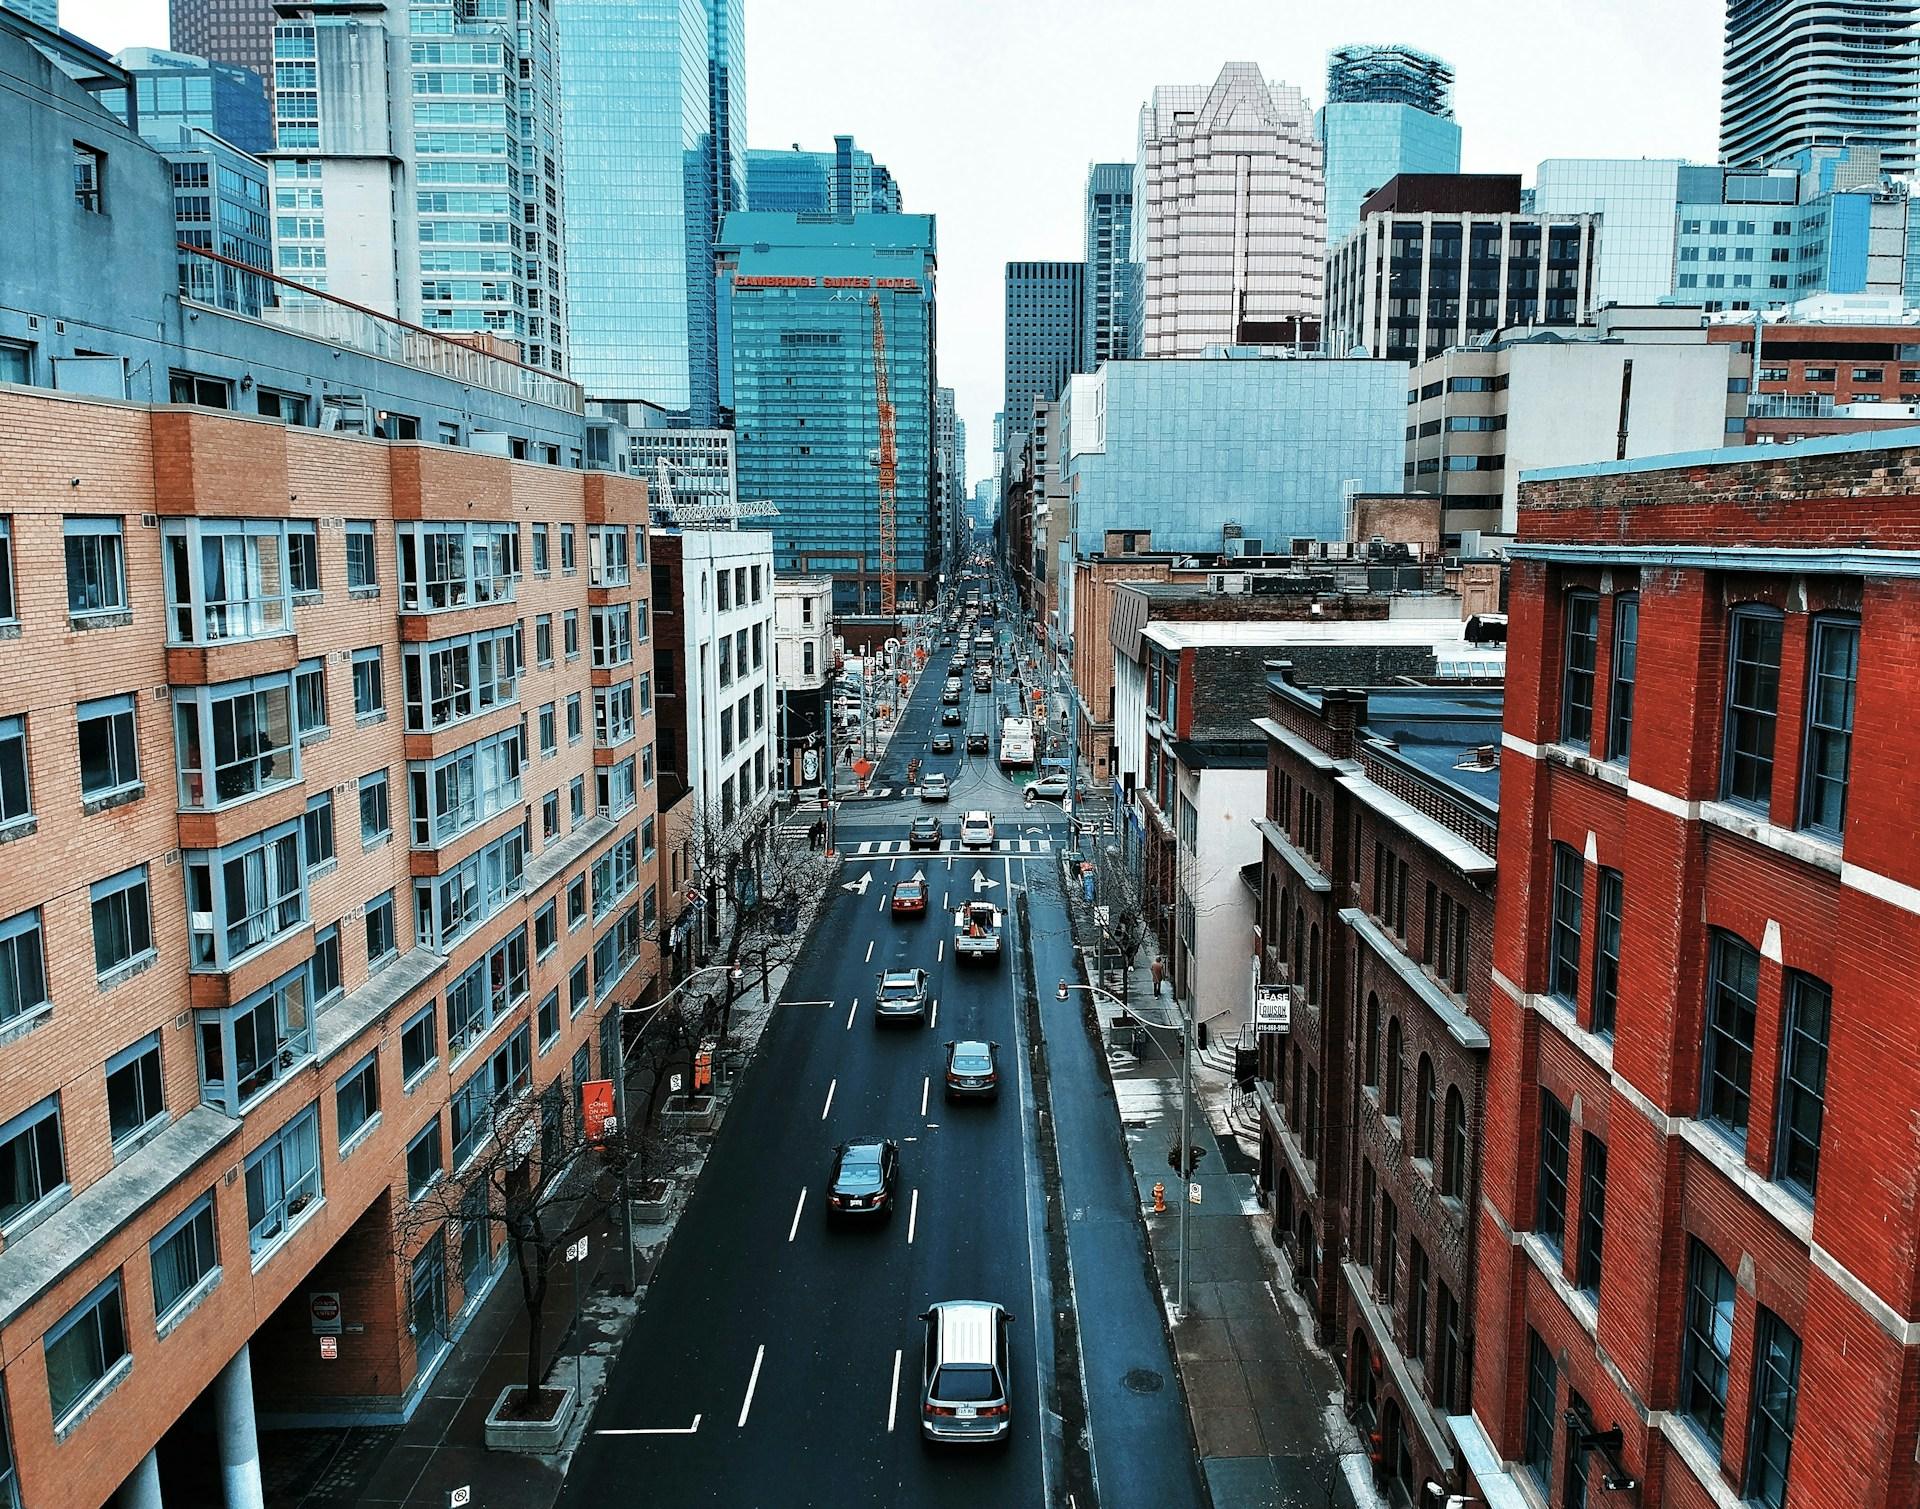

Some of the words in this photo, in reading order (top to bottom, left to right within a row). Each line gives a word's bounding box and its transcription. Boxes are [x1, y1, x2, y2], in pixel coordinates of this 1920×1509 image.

[735, 275, 817, 288] CAMBRIDGE
[823, 276, 871, 288] SUITES
[876, 277, 917, 288] HOTEL
[1259, 993, 1289, 1001] LEASE
[588, 1101, 608, 1109] COME
